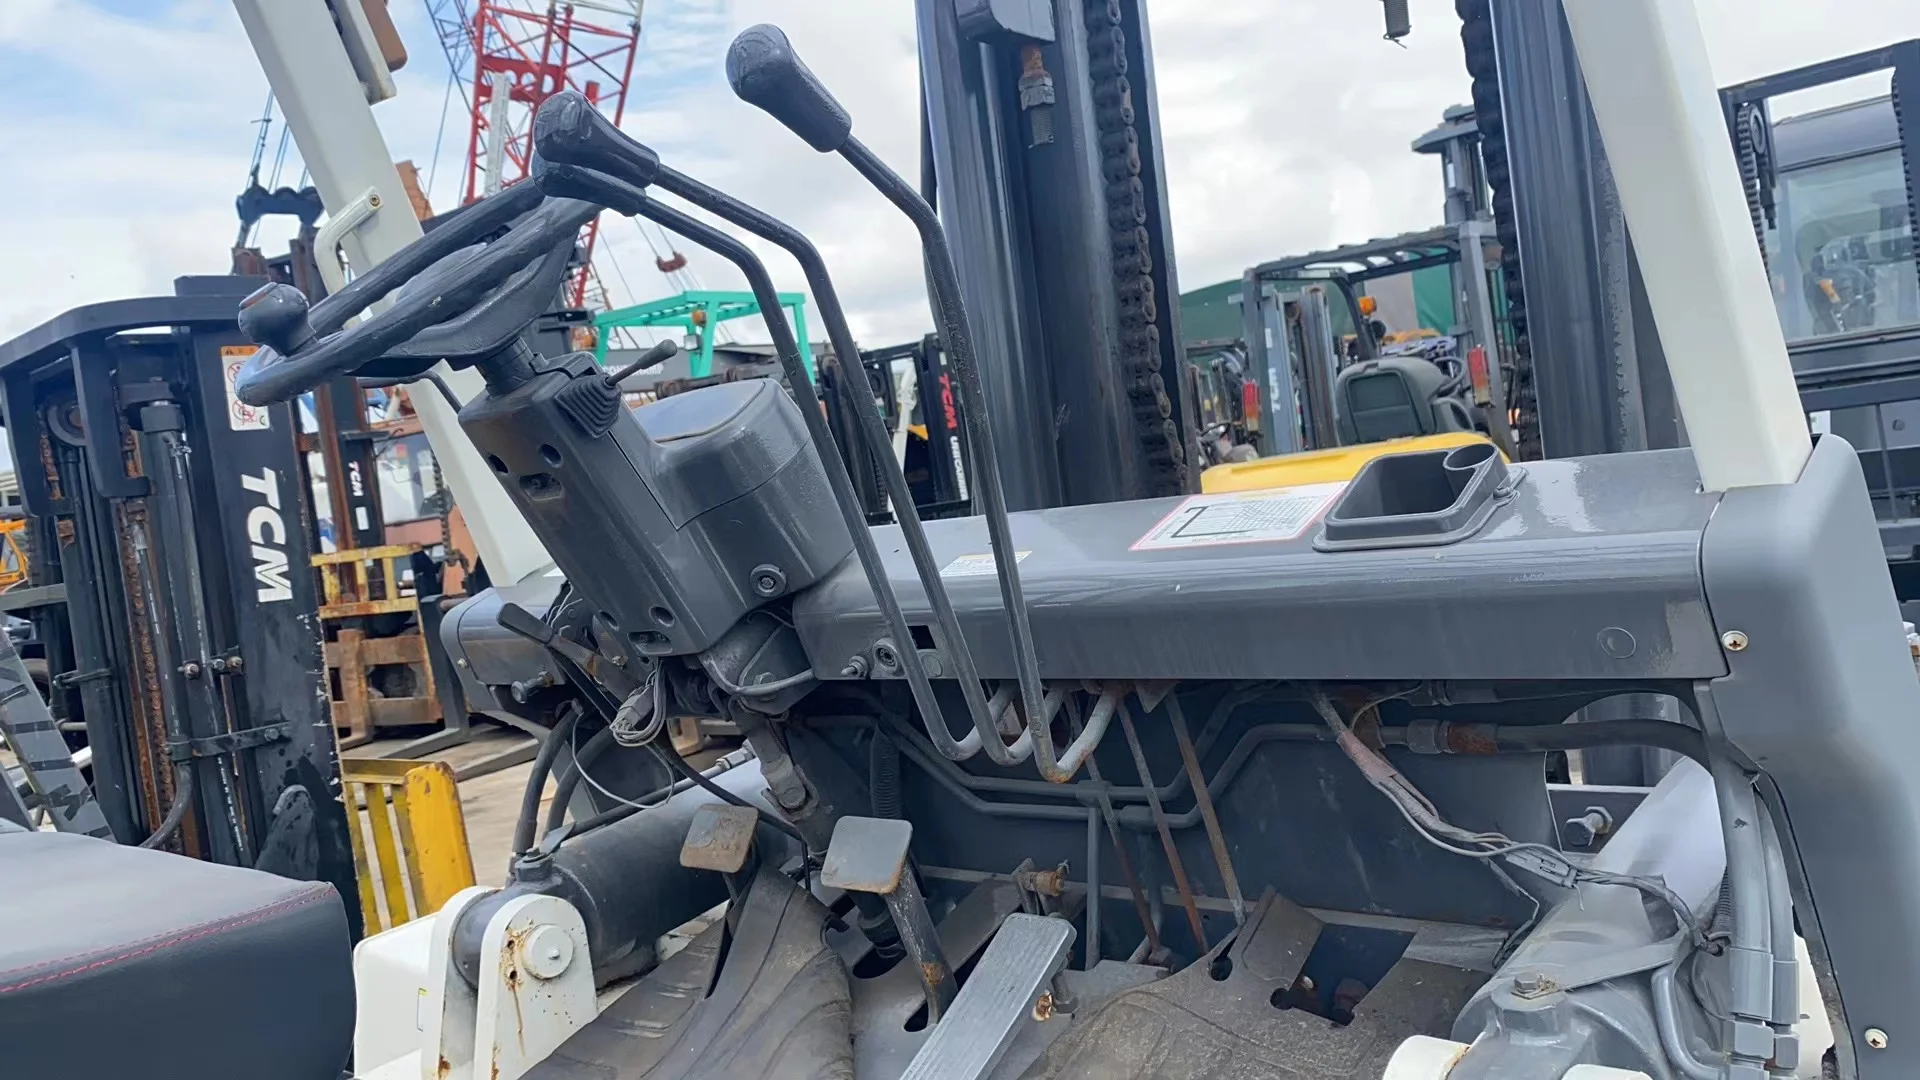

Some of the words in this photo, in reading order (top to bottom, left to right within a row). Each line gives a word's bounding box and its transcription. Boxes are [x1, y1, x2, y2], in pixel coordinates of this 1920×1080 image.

[938, 372, 958, 429] TCM
[348, 461, 364, 495] TCM
[241, 466, 293, 603] TCM
